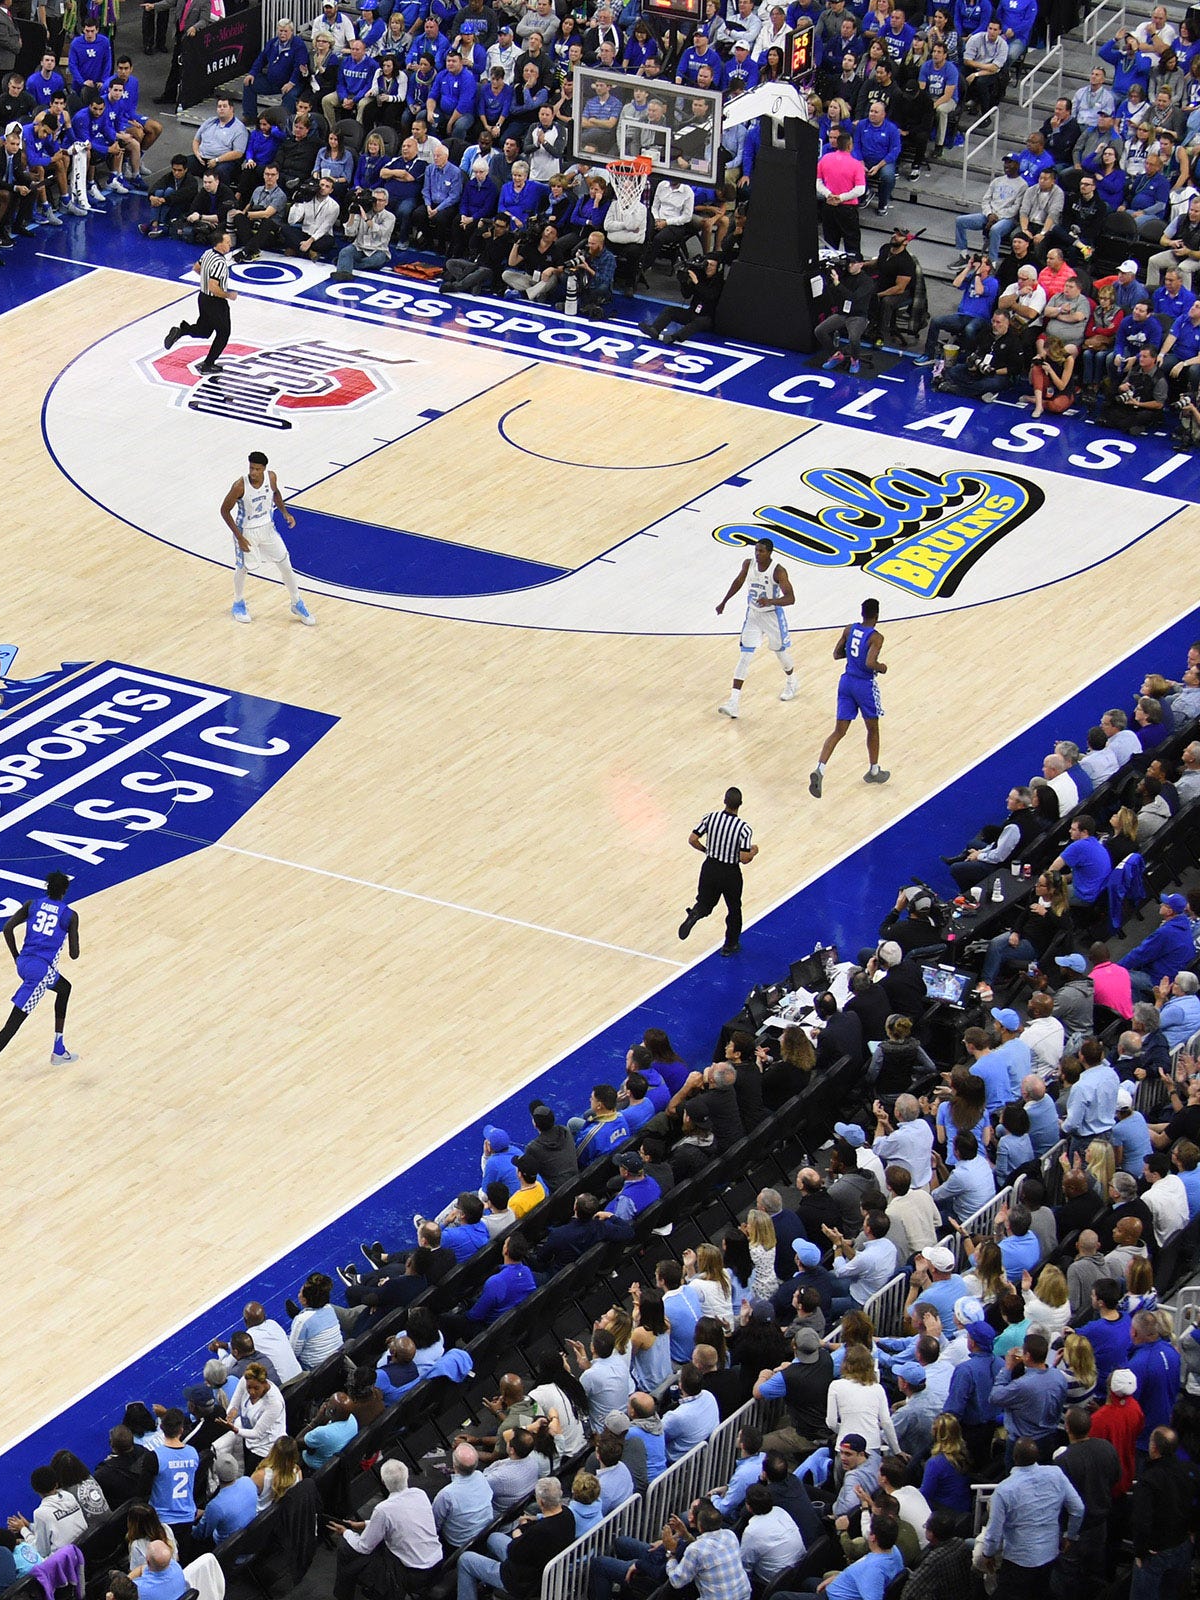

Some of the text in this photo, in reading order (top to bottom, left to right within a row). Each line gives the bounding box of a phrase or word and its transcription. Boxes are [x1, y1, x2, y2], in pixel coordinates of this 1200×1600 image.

[206, 54, 237, 75] ARENA
[343, 68, 368, 79] KENTUCKY
[324, 282, 713, 374] CBS SPORTS
[879, 493, 1016, 590] BRUINS
[850, 639, 861, 658] 5
[32, 910, 59, 937] 32
[609, 1127, 627, 1144] UCLA
[168, 1459, 189, 1469] BERRY
[172, 1471, 189, 1499] 2
